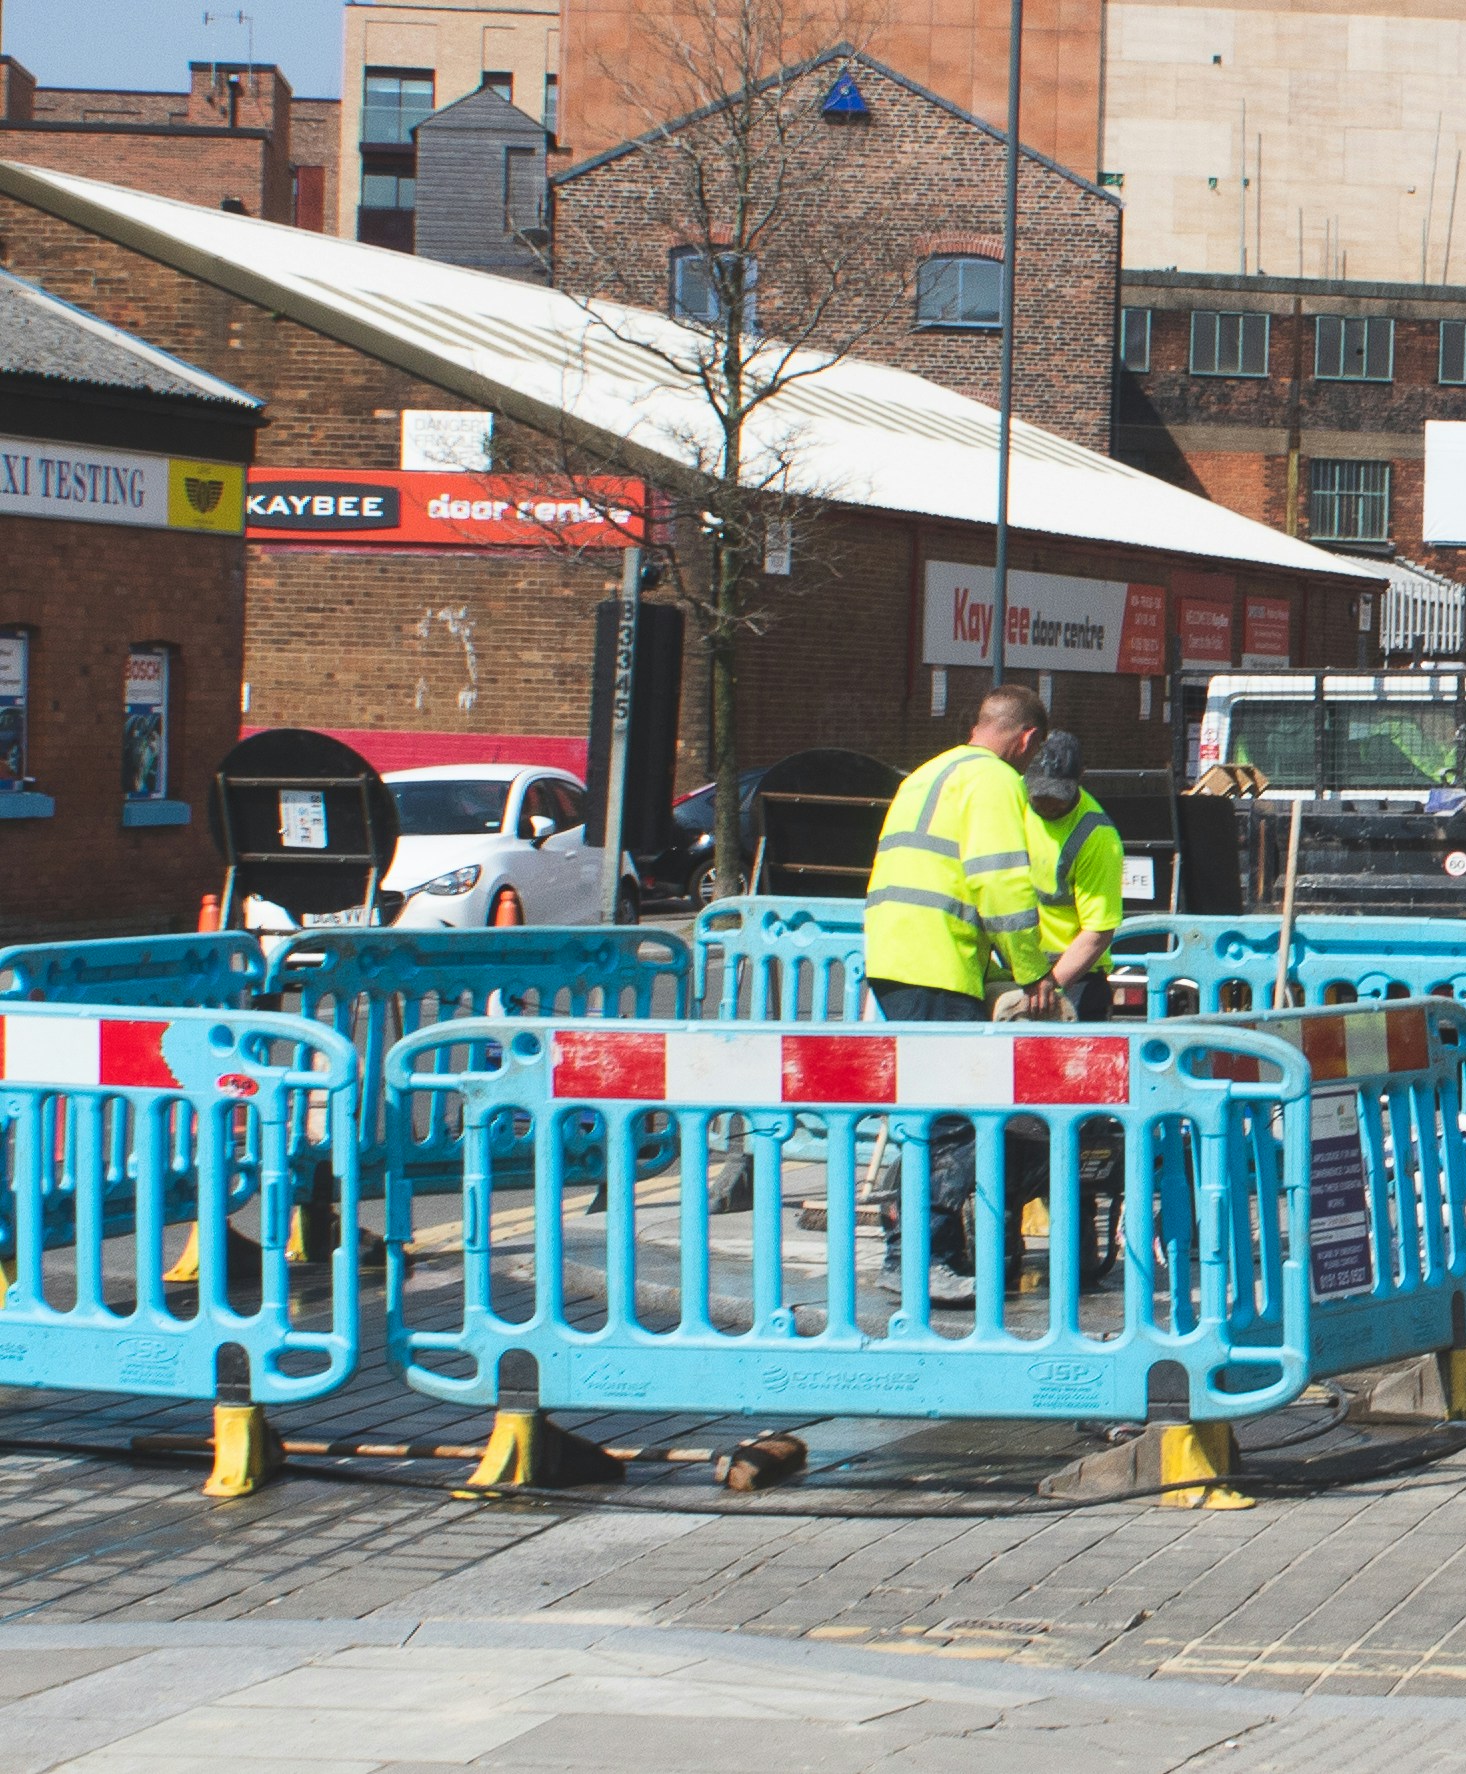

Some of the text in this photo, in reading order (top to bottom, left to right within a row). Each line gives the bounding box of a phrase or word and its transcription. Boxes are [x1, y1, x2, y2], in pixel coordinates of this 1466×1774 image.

[0, 454, 145, 508] XI TESTING
[247, 496, 384, 517] KAYBEE
[428, 494, 508, 521] door
[953, 587, 1030, 659] Kayee
[1032, 611, 1062, 647] door
[1063, 615, 1105, 650] centre
[1039, 1363, 1090, 1381] JSP
